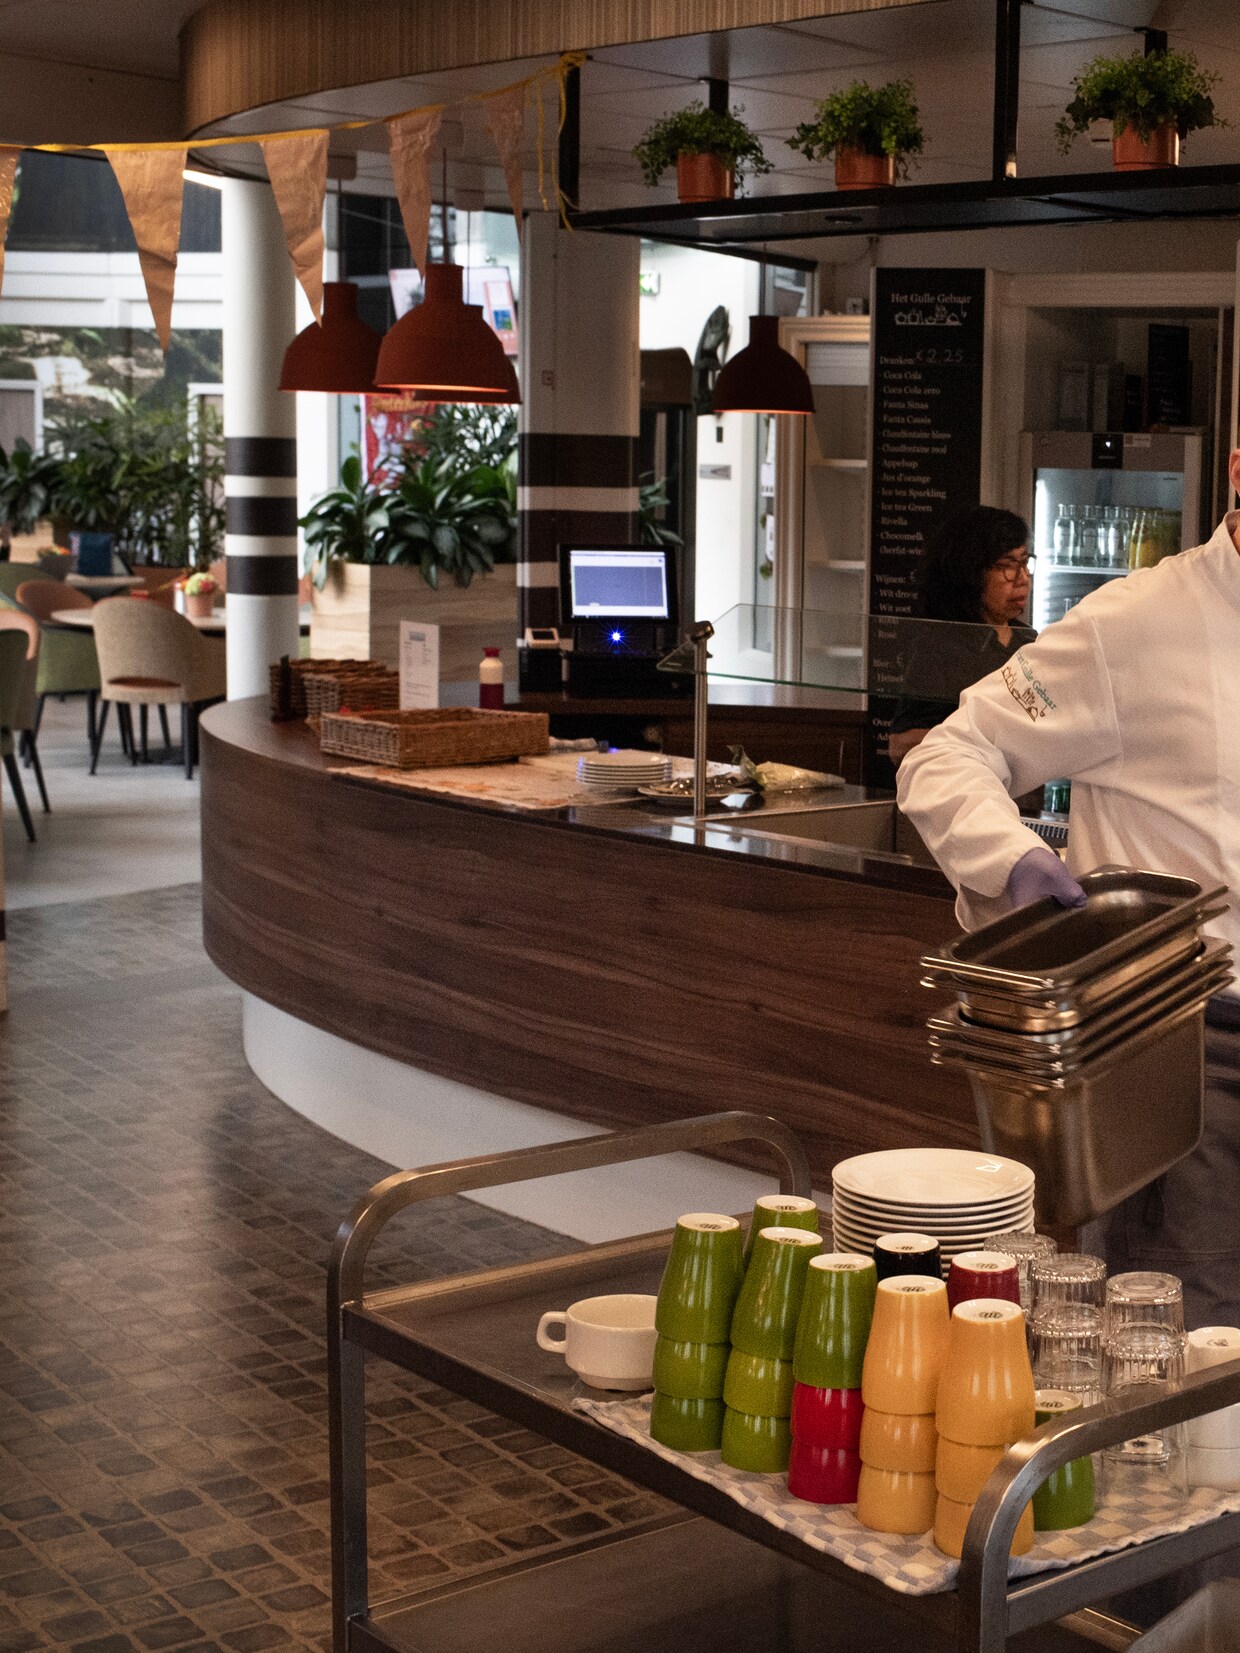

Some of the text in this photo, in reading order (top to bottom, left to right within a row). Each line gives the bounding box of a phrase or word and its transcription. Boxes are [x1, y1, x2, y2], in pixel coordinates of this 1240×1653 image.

[891, 293, 972, 304] Het Gulle Gebaar
[883, 371, 922, 380] Coca Cola
[883, 386, 902, 394] Coca
[904, 386, 922, 394] Cola
[883, 400, 929, 410] Fanta Sinas
[883, 415, 932, 424] Fanta Cassis
[882, 473, 896, 482] Jus
[882, 488, 947, 500] Ice tea Sparkling
[881, 503, 932, 512] Ice tea Green
[881, 517, 908, 526] Rivella
[880, 531, 924, 540] Chocomelk
[880, 589, 894, 598] Wit
[880, 603, 894, 612] Wit
[1032, 680, 1057, 710] Gebaar
